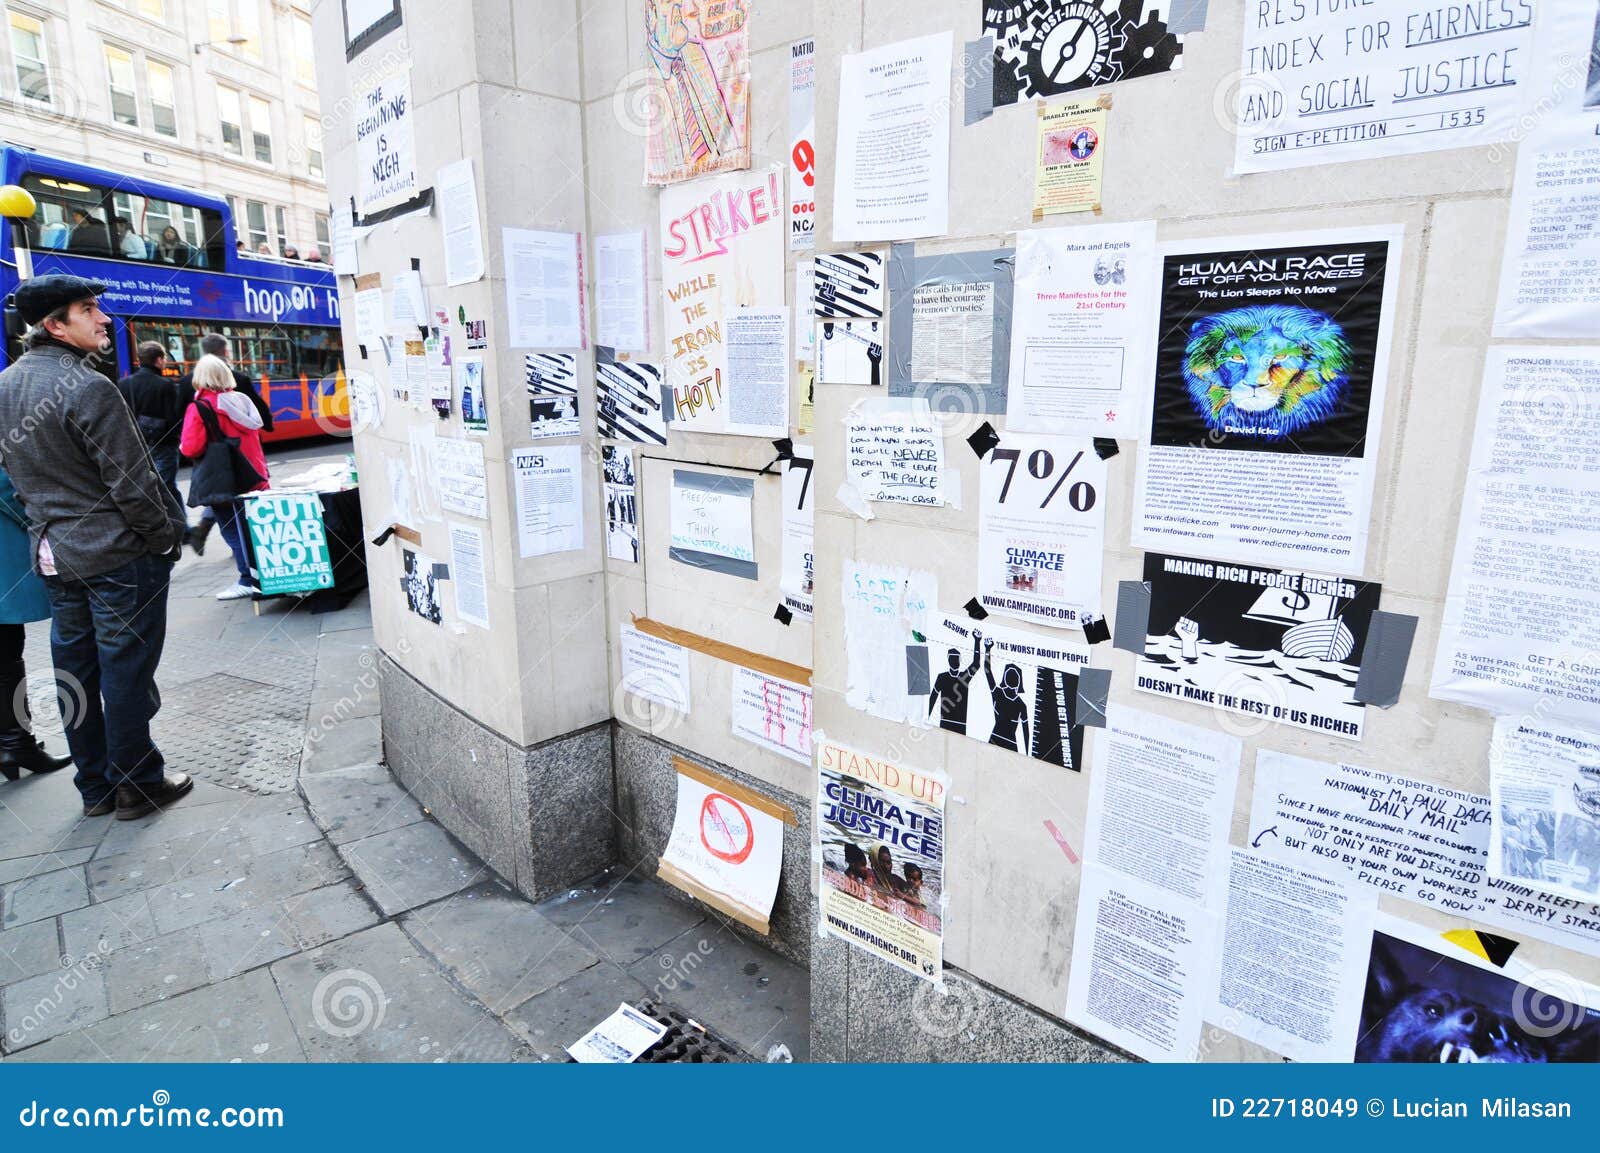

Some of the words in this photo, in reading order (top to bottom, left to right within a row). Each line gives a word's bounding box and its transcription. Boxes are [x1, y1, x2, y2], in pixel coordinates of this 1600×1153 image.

[986, 8, 1003, 23] WE
[1008, 34, 1019, 49] IN
[1036, 4, 1109, 52] POST-INDUSTRIAL
[1086, 54, 1106, 80] AGE
[1247, 34, 1323, 75] INDEX
[1345, 21, 1389, 56] FOR
[1406, 0, 1532, 45] FAIRNESS
[1244, 91, 1282, 122] AND
[1299, 76, 1375, 113] SOCIAL
[1394, 48, 1518, 99] JUSTICE
[367, 87, 383, 108] THE
[358, 95, 406, 141] BEGINNING
[1043, 112, 1069, 120] BRADLEY
[1254, 136, 1286, 153] SIGN
[1296, 123, 1387, 148] E-PETITION
[1440, 108, 1485, 128] 1535
[377, 134, 387, 155] IS
[372, 152, 399, 183] NIGH
[664, 173, 779, 257] STRIKE!
[1104, 242, 1130, 250] Engels
[1179, 258, 1277, 276] HUMAN
[1286, 253, 1366, 270] RACE
[123, 279, 137, 288] with
[138, 281, 150, 291] The
[176, 285, 190, 294] Trust
[668, 273, 716, 302] WHILE
[952, 283, 962, 292] for
[964, 283, 990, 293] judges
[1178, 276, 1209, 286] GET
[1213, 275, 1245, 284] OFF
[1250, 272, 1299, 283] YOUR
[1303, 269, 1364, 279] KNEES
[244, 280, 285, 321] hop
[1198, 289, 1218, 298] The
[1221, 288, 1243, 298] Lion
[1247, 286, 1282, 297] Sleeps
[1284, 286, 1302, 295] No
[1305, 285, 1337, 294] More
[682, 302, 707, 324] THE
[921, 305, 949, 314] remove
[672, 321, 721, 359] IRON
[688, 356, 708, 376] IS
[674, 368, 722, 422] HOT!
[1224, 425, 1256, 435] David
[1258, 426, 1279, 436] Icke
[893, 449, 937, 461] NEVER
[905, 439, 934, 447] SINKS
[519, 457, 542, 467] NHS
[880, 471, 899, 481] THE
[902, 474, 937, 489] POLICE
[990, 448, 1096, 512] 7%
[252, 520, 325, 546] WAR
[687, 522, 719, 539] THINK
[1144, 513, 1219, 527] www.davidicke.com
[1230, 522, 1351, 542] www.our-journey-home.com
[1143, 526, 1214, 540] www.infowars.com
[1239, 536, 1350, 556] www.redicecreations.com
[256, 542, 322, 568] NOT
[1006, 547, 1065, 562] CLIMATE
[1006, 556, 1064, 571] JUSTICE
[261, 562, 329, 579] WELFARE
[1164, 558, 1213, 578] MAKING
[1216, 566, 1248, 584] RICH
[1251, 572, 1299, 591] PEOPLE
[1302, 579, 1356, 599] RICHER
[983, 595, 1076, 621] WWW.CAMPAIGNCC.ORG
[943, 619, 969, 638] ASSUME
[996, 641, 1009, 651] THE
[1010, 644, 1036, 656] WORST
[1037, 647, 1060, 660] ABOUT
[1062, 652, 1088, 664] PEOPLE
[1528, 654, 1554, 666] GET
[1054, 672, 1063, 688] AND
[1056, 690, 1065, 706] YOU
[1138, 676, 1182, 696] DOESN'T
[1184, 687, 1215, 704] MAKE
[1218, 694, 1239, 708] THE
[1241, 699, 1270, 715] REST
[1273, 706, 1289, 720] OF
[1290, 710, 1308, 724] US
[1310, 714, 1359, 736] RICHER
[1058, 707, 1067, 722] GET
[1059, 723, 1069, 738] THE
[1061, 739, 1072, 768] WORST
[822, 745, 900, 791] STAND
[910, 776, 944, 803] UP
[1324, 778, 1386, 799] NATIONALIST
[1412, 793, 1447, 814] PAUL
[825, 782, 940, 838] CLIMATE
[823, 804, 938, 861] JUSTICE
[1285, 836, 1307, 850] BUT
[1312, 845, 1338, 858] ALSO
[1360, 859, 1387, 872] YOUR
[1392, 868, 1417, 880] OWN
[1423, 876, 1478, 899] WORKERS
[1503, 897, 1556, 921] DERRY
[1304, 827, 1328, 840] NOT
[1334, 835, 1364, 850] ONLY
[1369, 845, 1392, 858] ARE
[1396, 853, 1416, 864] YOU
[1417, 858, 1481, 884] DESPISED
[1487, 877, 1534, 897] WITHIN
[1538, 892, 1584, 910] FLEET
[827, 913, 917, 965] WWW.CAMPAIGNCC.ORG
